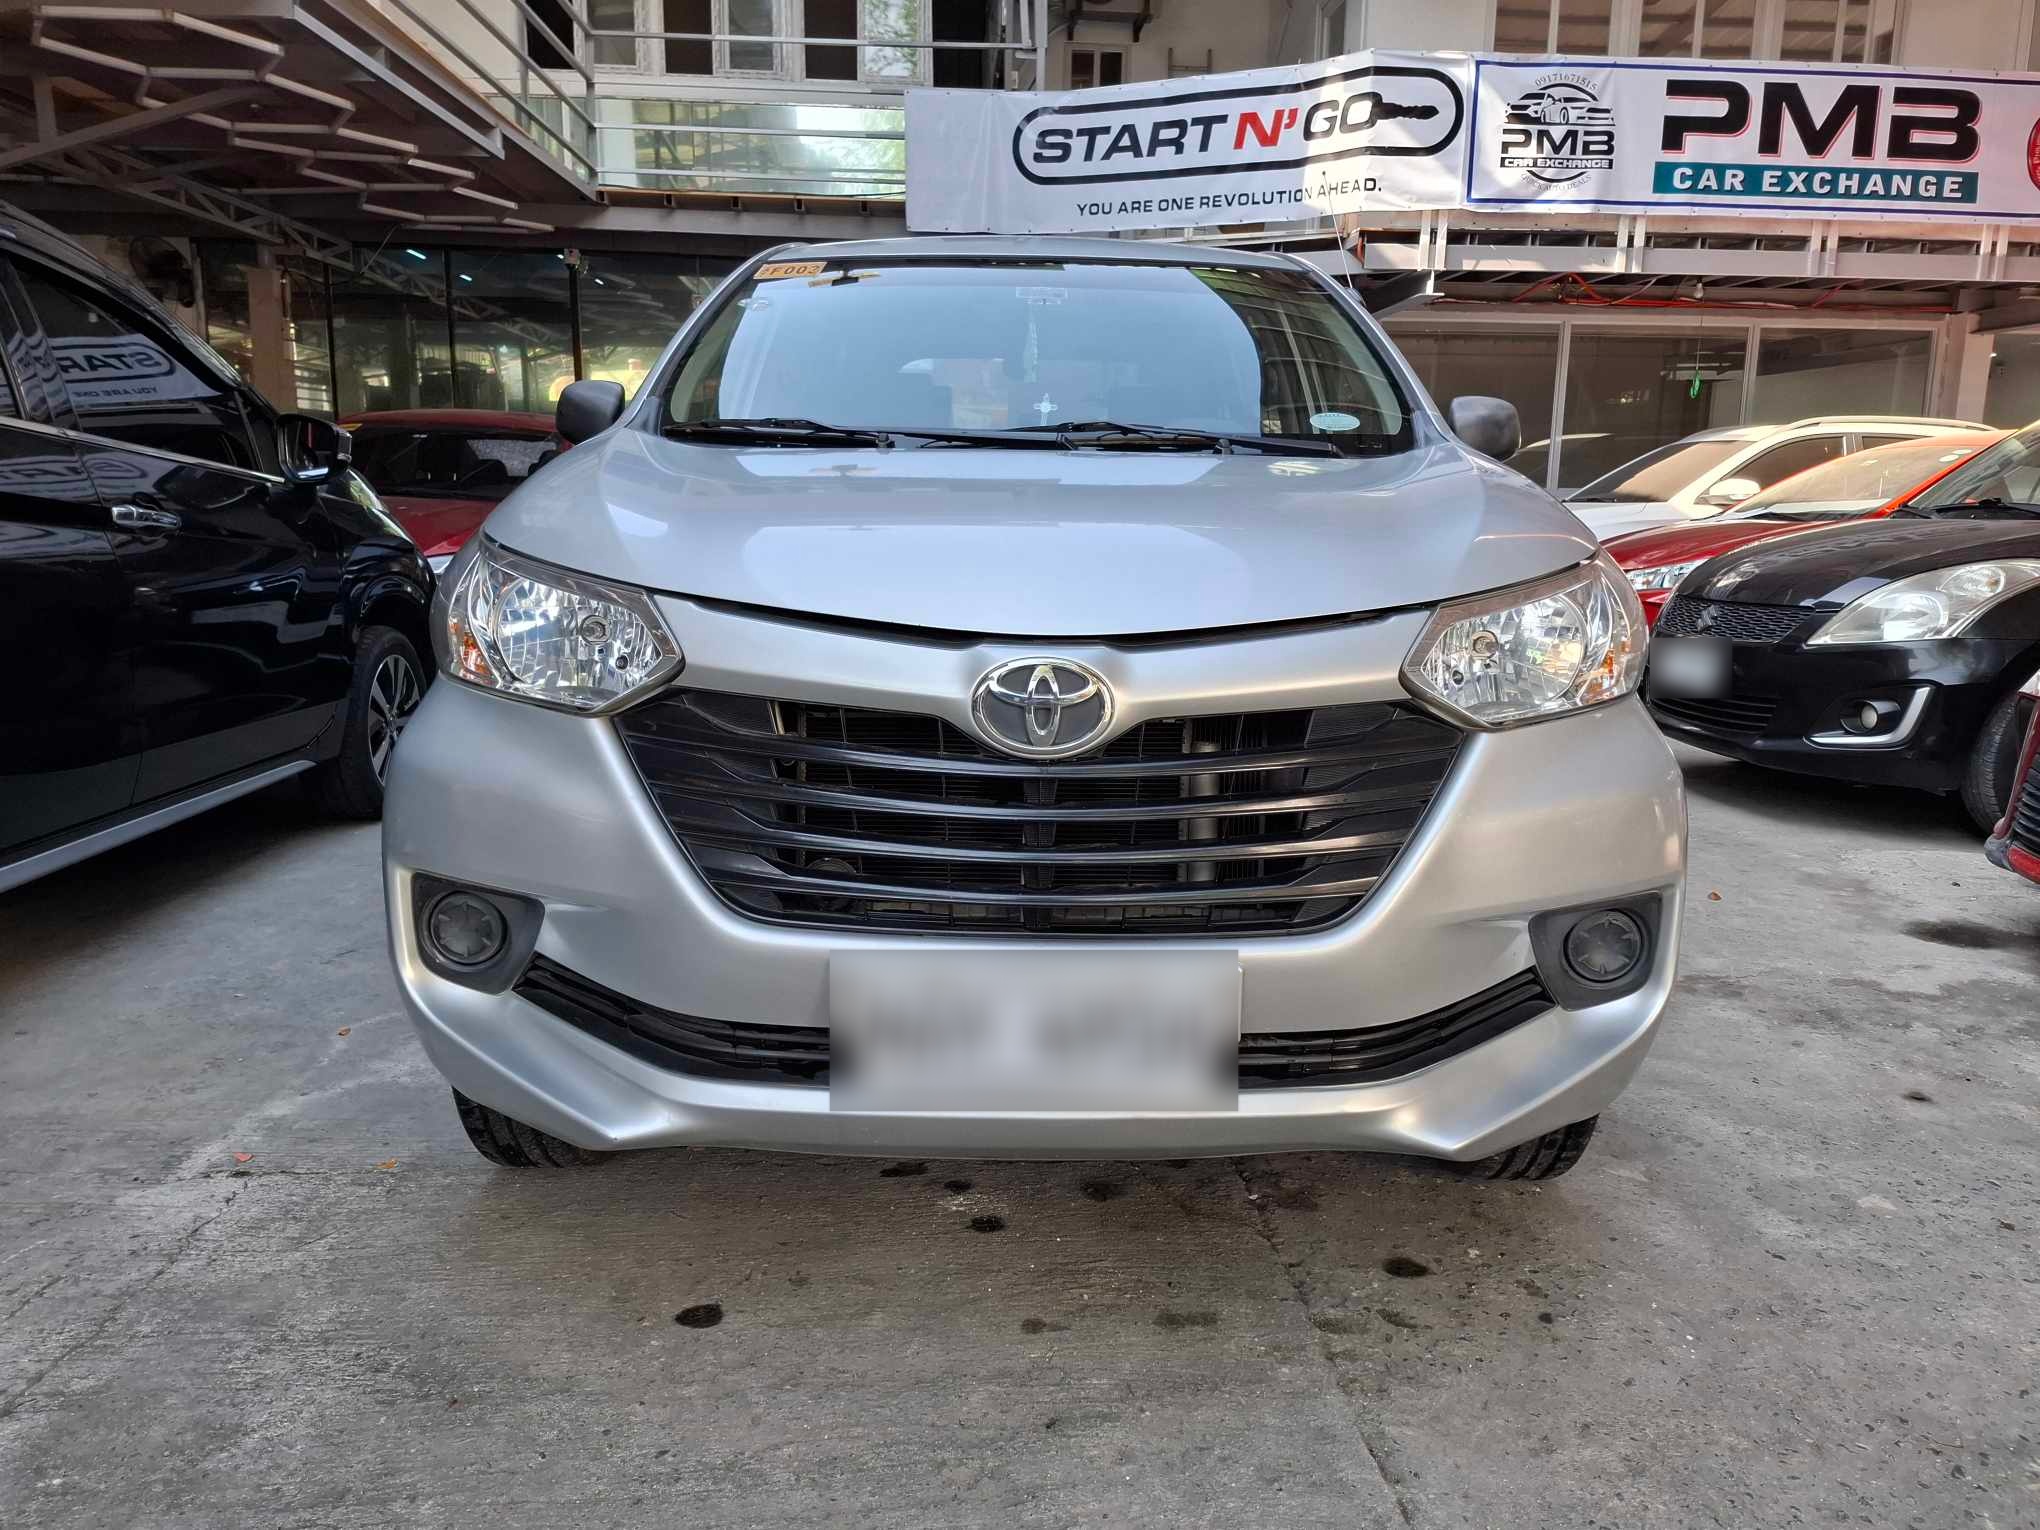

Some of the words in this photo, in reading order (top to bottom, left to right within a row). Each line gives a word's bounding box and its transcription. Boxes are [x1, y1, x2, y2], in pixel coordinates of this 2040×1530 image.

[1032, 113, 1229, 164] START
[1303, 91, 1384, 142] GO
[1662, 79, 1983, 164] PMB
[1501, 128, 1615, 156] PMB
[1504, 158, 1534, 167] CAR
[1537, 158, 1610, 168] EXCHANGE
[1077, 202, 1112, 216] YOU
[1117, 200, 1153, 215] ARE
[1158, 197, 1195, 212] ONE
[1199, 187, 1313, 209] REVOLUTION
[1317, 177, 1383, 198] AHEAD.
[1672, 166, 1745, 193] CAR
[1762, 171, 1964, 199] EXCHANGE
